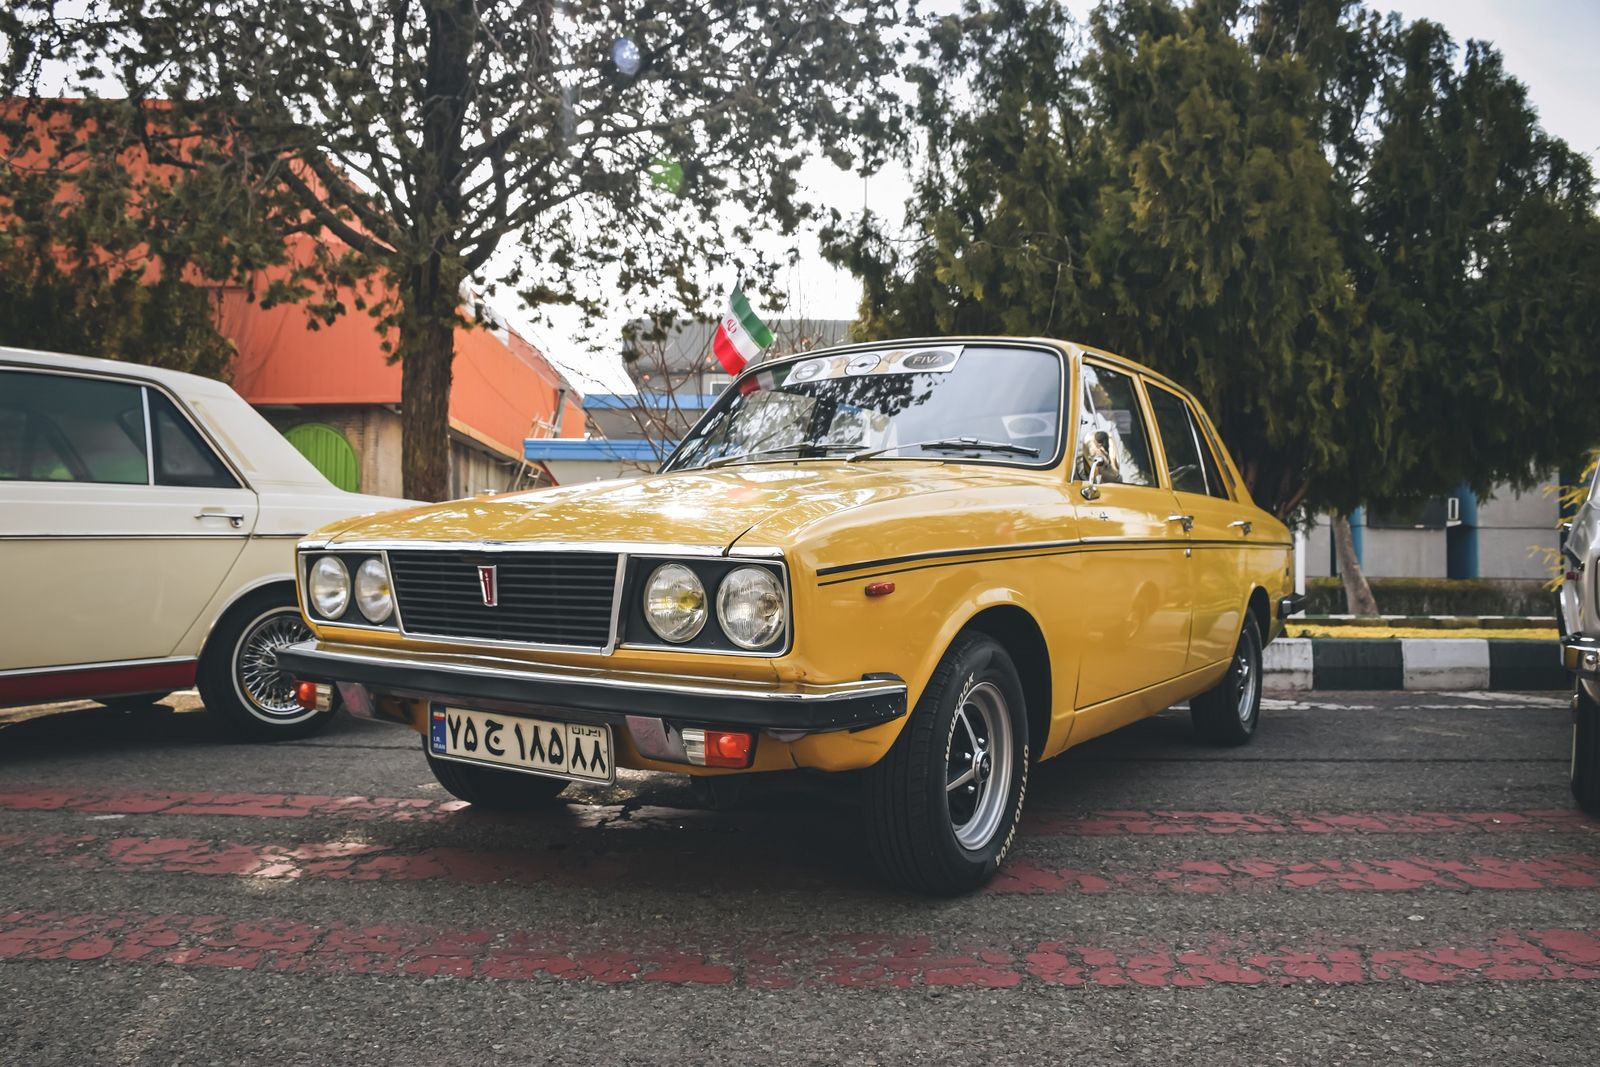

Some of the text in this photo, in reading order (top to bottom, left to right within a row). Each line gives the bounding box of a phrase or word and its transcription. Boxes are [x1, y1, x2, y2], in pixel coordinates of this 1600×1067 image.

[912, 356, 944, 365] FIVA
[448, 713, 565, 765] ۷۵ ج ۱۸۵
[571, 726, 601, 738] ایران
[571, 737, 606, 774] ۸۸
[1014, 744, 1029, 823] OPTIMO
